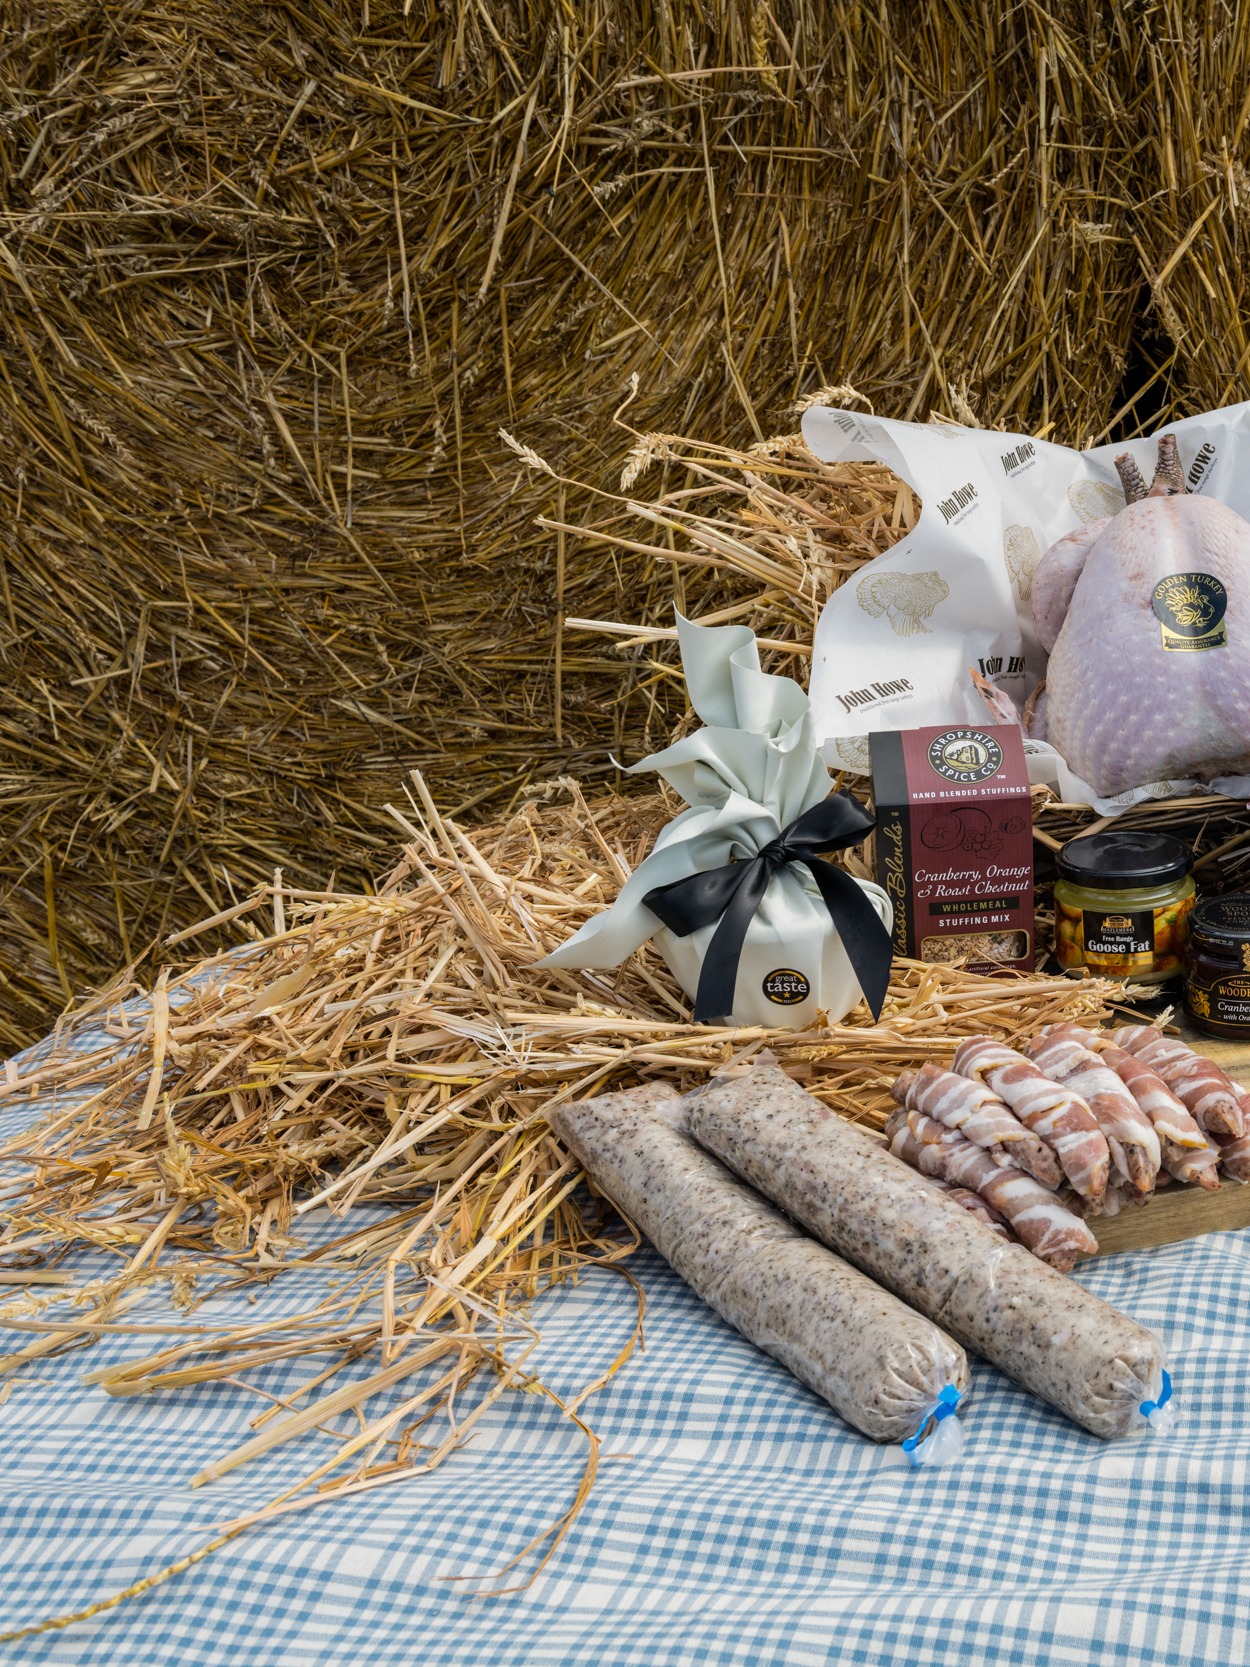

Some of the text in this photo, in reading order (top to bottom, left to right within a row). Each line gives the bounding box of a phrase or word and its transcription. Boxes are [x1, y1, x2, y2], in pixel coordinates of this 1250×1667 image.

[1001, 452, 1019, 476] John
[1015, 442, 1036, 464] Howe
[936, 498, 960, 525] John
[951, 482, 978, 509] Howe
[1154, 574, 1224, 600] GOLDEN TURKEY
[1190, 636, 1220, 645] ASSURANCE
[1007, 656, 1025, 673] Ho
[835, 678, 914, 714] John Howe
[931, 731, 999, 757] SHROPSHIRE
[939, 765, 977, 781] SPICE
[912, 786, 1027, 799] HAND BLENDED STUFFINGS
[914, 864, 1031, 883] Cranberry, Orange
[883, 820, 908, 957] lassic Blends
[917, 879, 1030, 898] & Roast Chestnut
[942, 900, 1007, 912] WHOLEMEAL
[939, 914, 1010, 927] STUFFING MIX
[1088, 939, 1150, 953] Goose Fat
[1115, 935, 1134, 943] Range
[775, 975, 797, 983] great
[766, 982, 807, 993] taste
